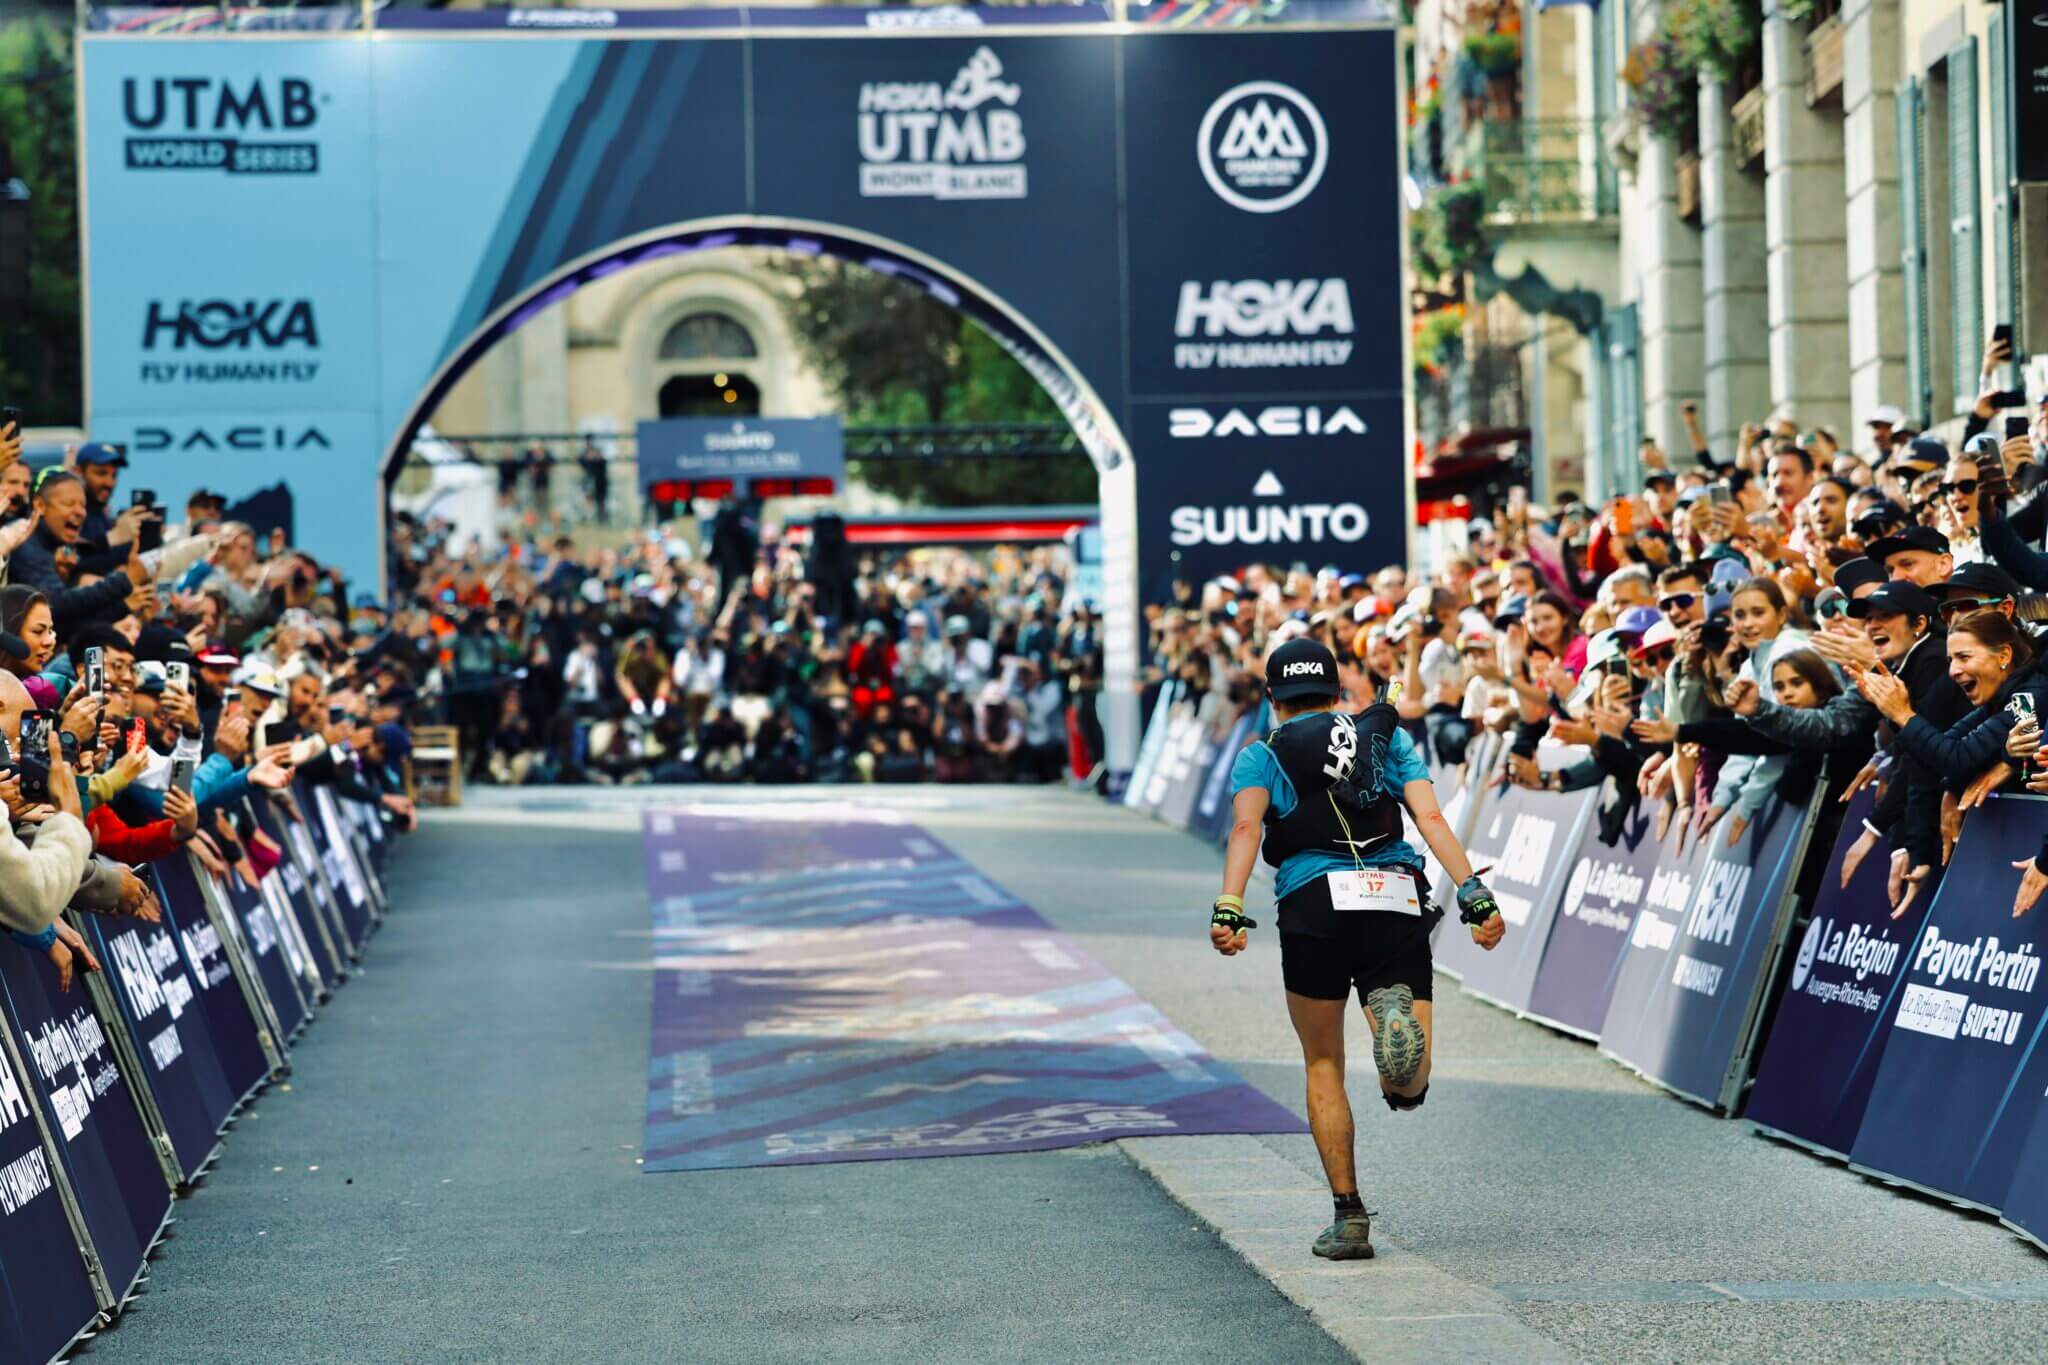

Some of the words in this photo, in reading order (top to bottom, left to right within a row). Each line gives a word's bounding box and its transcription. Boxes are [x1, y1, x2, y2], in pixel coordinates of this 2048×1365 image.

[123, 77, 317, 132] UTMB
[858, 82, 943, 112] HOKA
[131, 141, 227, 166] WORLD
[233, 147, 315, 173] SERIES
[858, 110, 1027, 163] UTMB
[142, 299, 320, 350] HOKA
[1174, 277, 1354, 338] HOKA
[141, 362, 179, 383] FLY
[183, 362, 276, 383] HUMAN
[281, 361, 320, 383] FLY
[1174, 341, 1216, 369] FLY
[1217, 341, 1308, 368] HUMAN
[1311, 338, 1353, 366] FLY
[134, 425, 331, 450] DACIA
[1168, 406, 1367, 438] DACIA
[1170, 502, 1370, 546] SUUNTO
[1283, 661, 1324, 678] HOKA
[1367, 881, 1385, 892] 17
[1687, 860, 1752, 946] HOKA
[1817, 918, 1844, 963] La
[1838, 923, 1899, 981] Région
[1914, 926, 1982, 986] Payot
[1974, 936, 2041, 993] Pertin
[108, 928, 166, 1022] HOKA
[1805, 974, 1882, 1013] Auvergne-Rhône-Alpes
[1961, 1003, 2010, 1042] SUPER
[2004, 1012, 2023, 1045] U
